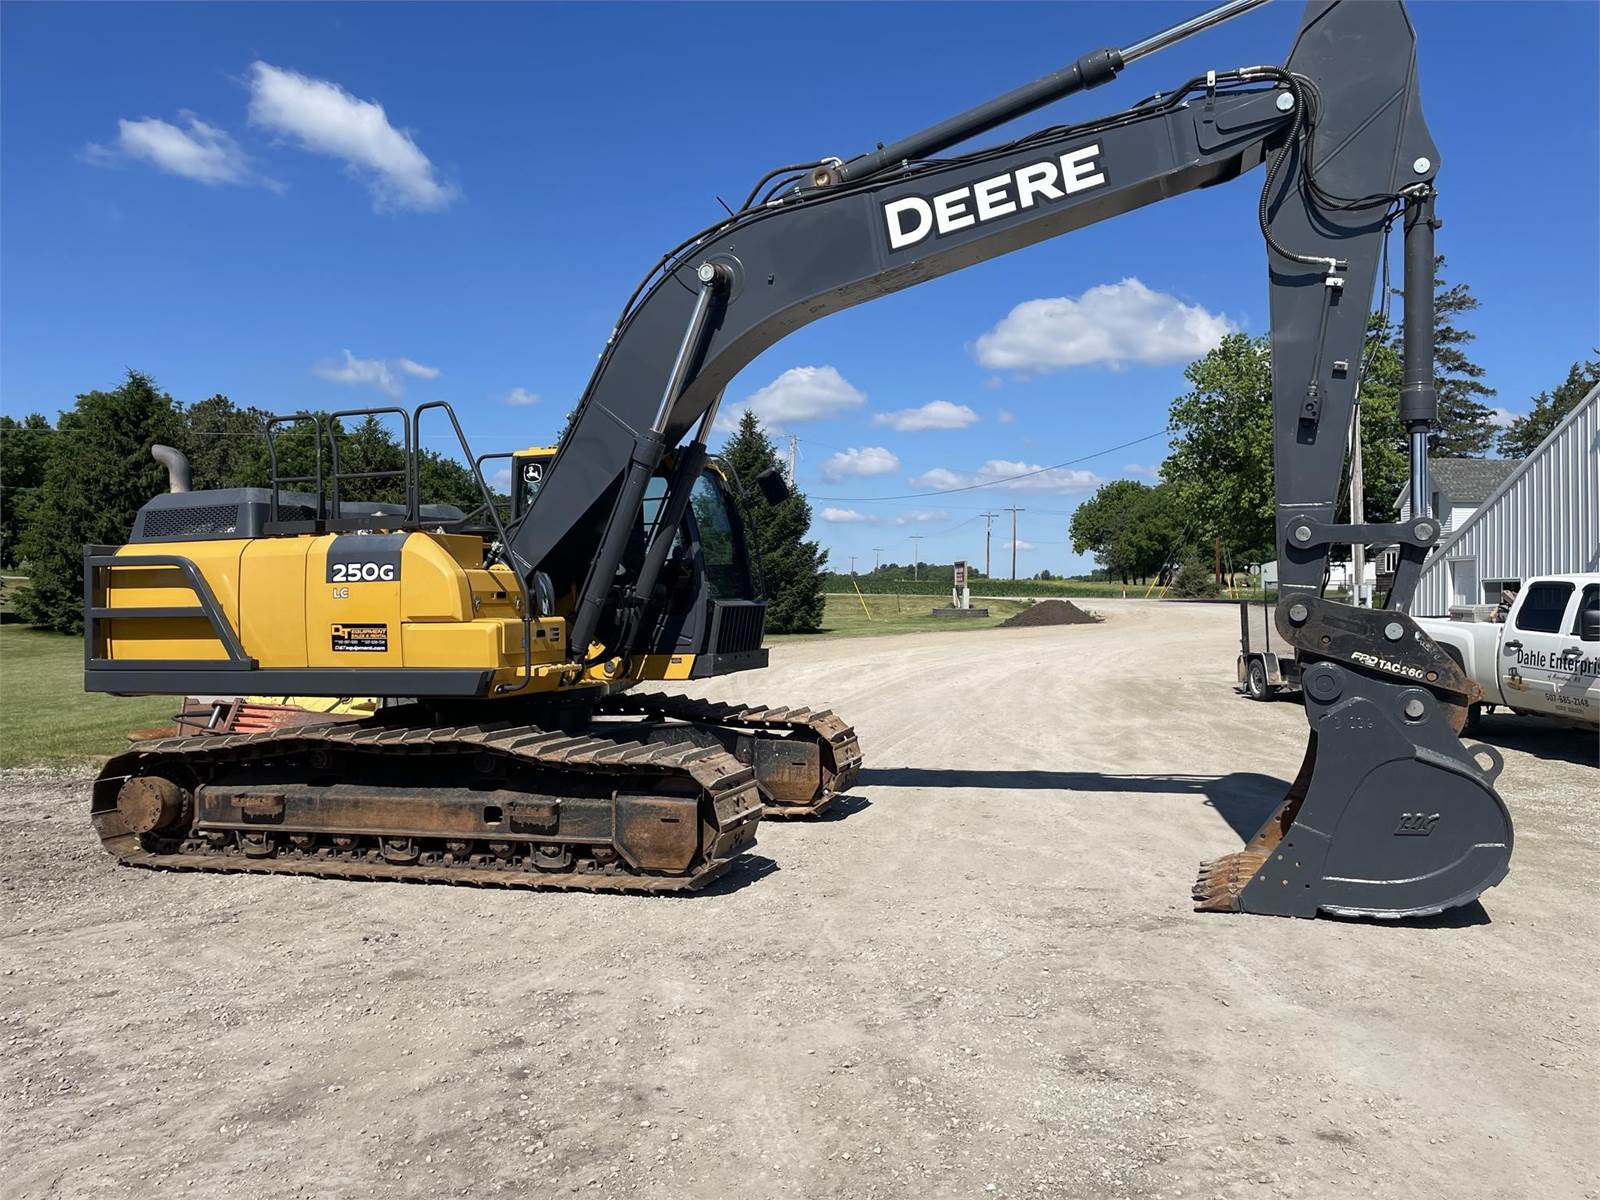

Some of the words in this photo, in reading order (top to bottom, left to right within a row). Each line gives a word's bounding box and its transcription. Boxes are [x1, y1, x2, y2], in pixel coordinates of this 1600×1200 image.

[884, 144, 1105, 249] DEERE
[332, 563, 394, 582] 250G
[333, 587, 349, 599] LC
[1517, 649, 1546, 667] Dahle
